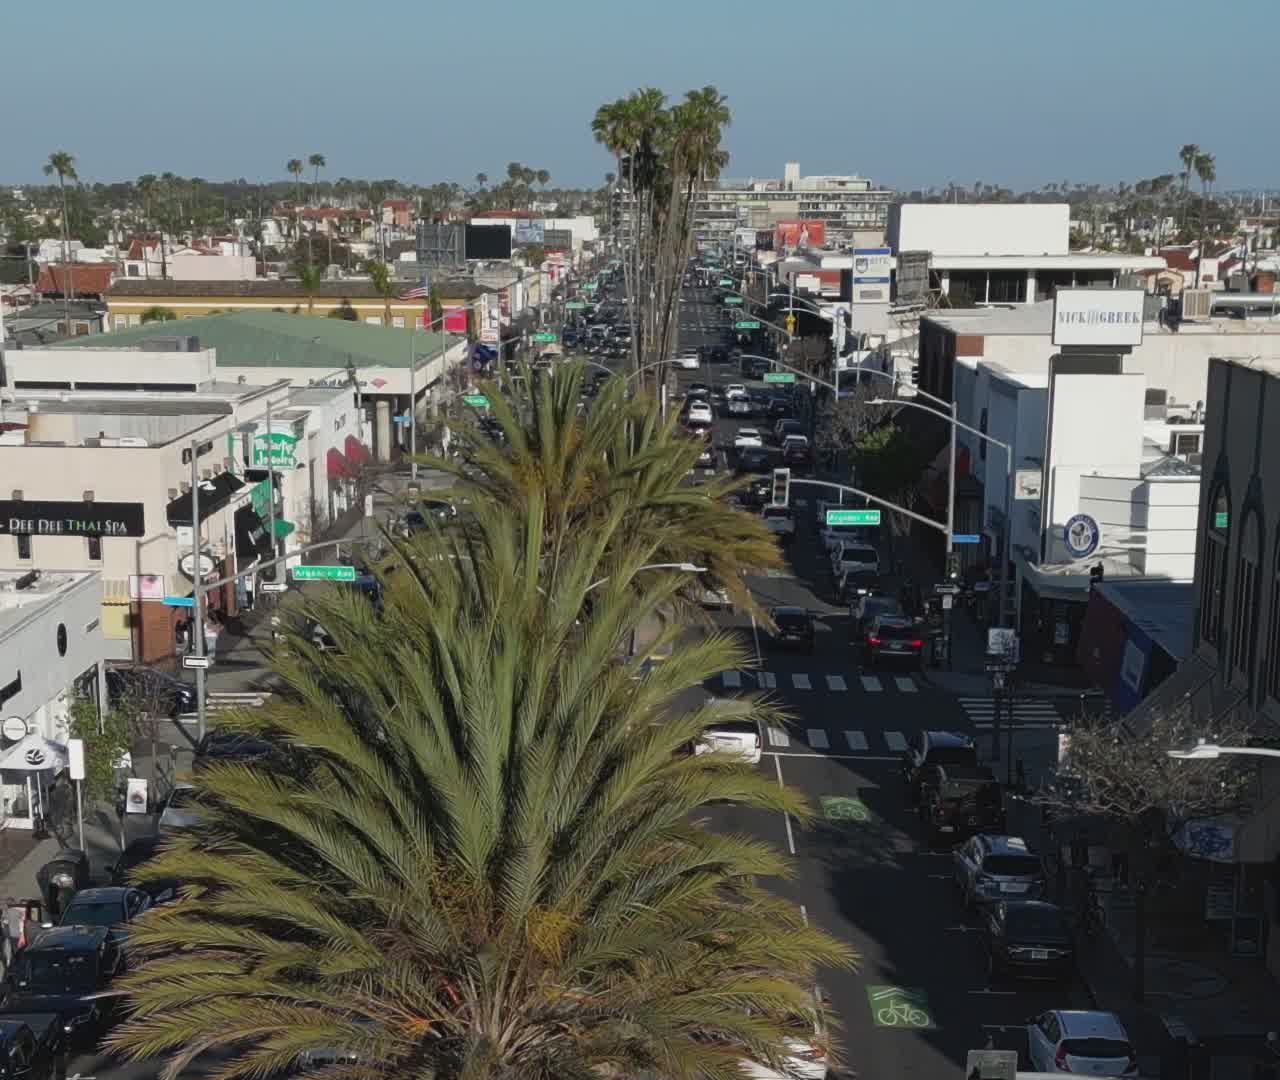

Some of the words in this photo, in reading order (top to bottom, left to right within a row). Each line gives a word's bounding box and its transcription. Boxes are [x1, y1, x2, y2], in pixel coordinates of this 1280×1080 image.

[9, 518, 35, 532] DEE
[38, 518, 65, 533] DEE
[68, 519, 102, 532] THAI
[104, 519, 129, 534] SPA
